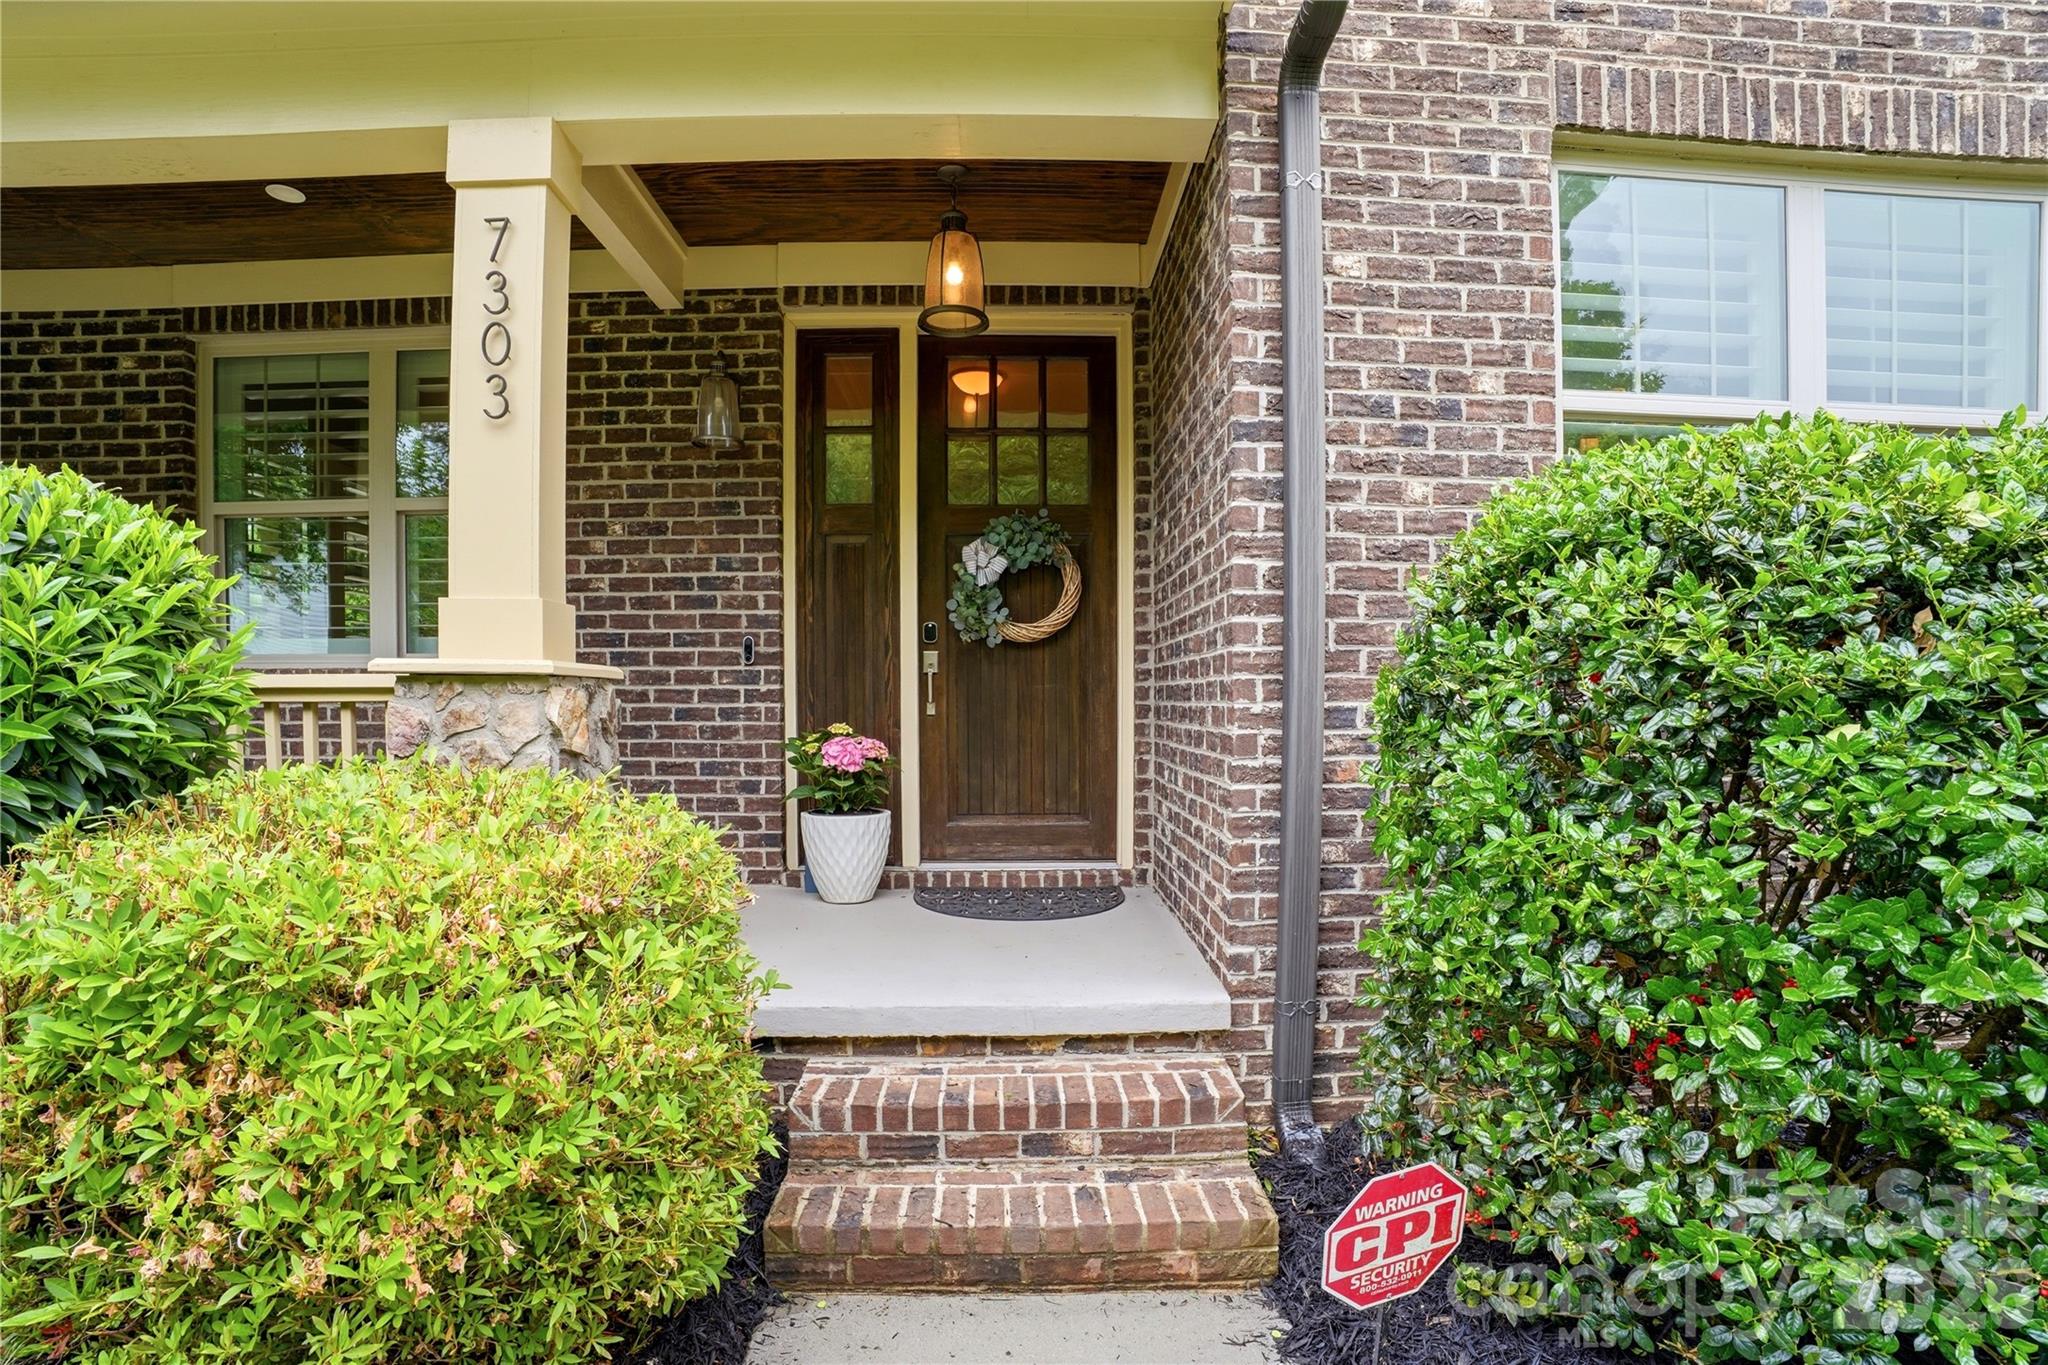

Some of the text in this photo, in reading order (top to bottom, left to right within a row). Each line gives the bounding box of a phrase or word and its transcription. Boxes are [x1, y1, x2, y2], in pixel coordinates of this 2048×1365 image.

[481, 216, 511, 420] 7303
[1355, 1183, 1443, 1222] WARNING
[1335, 1200, 1456, 1273] CPI
[1350, 1251, 1432, 1290] SECURITY
